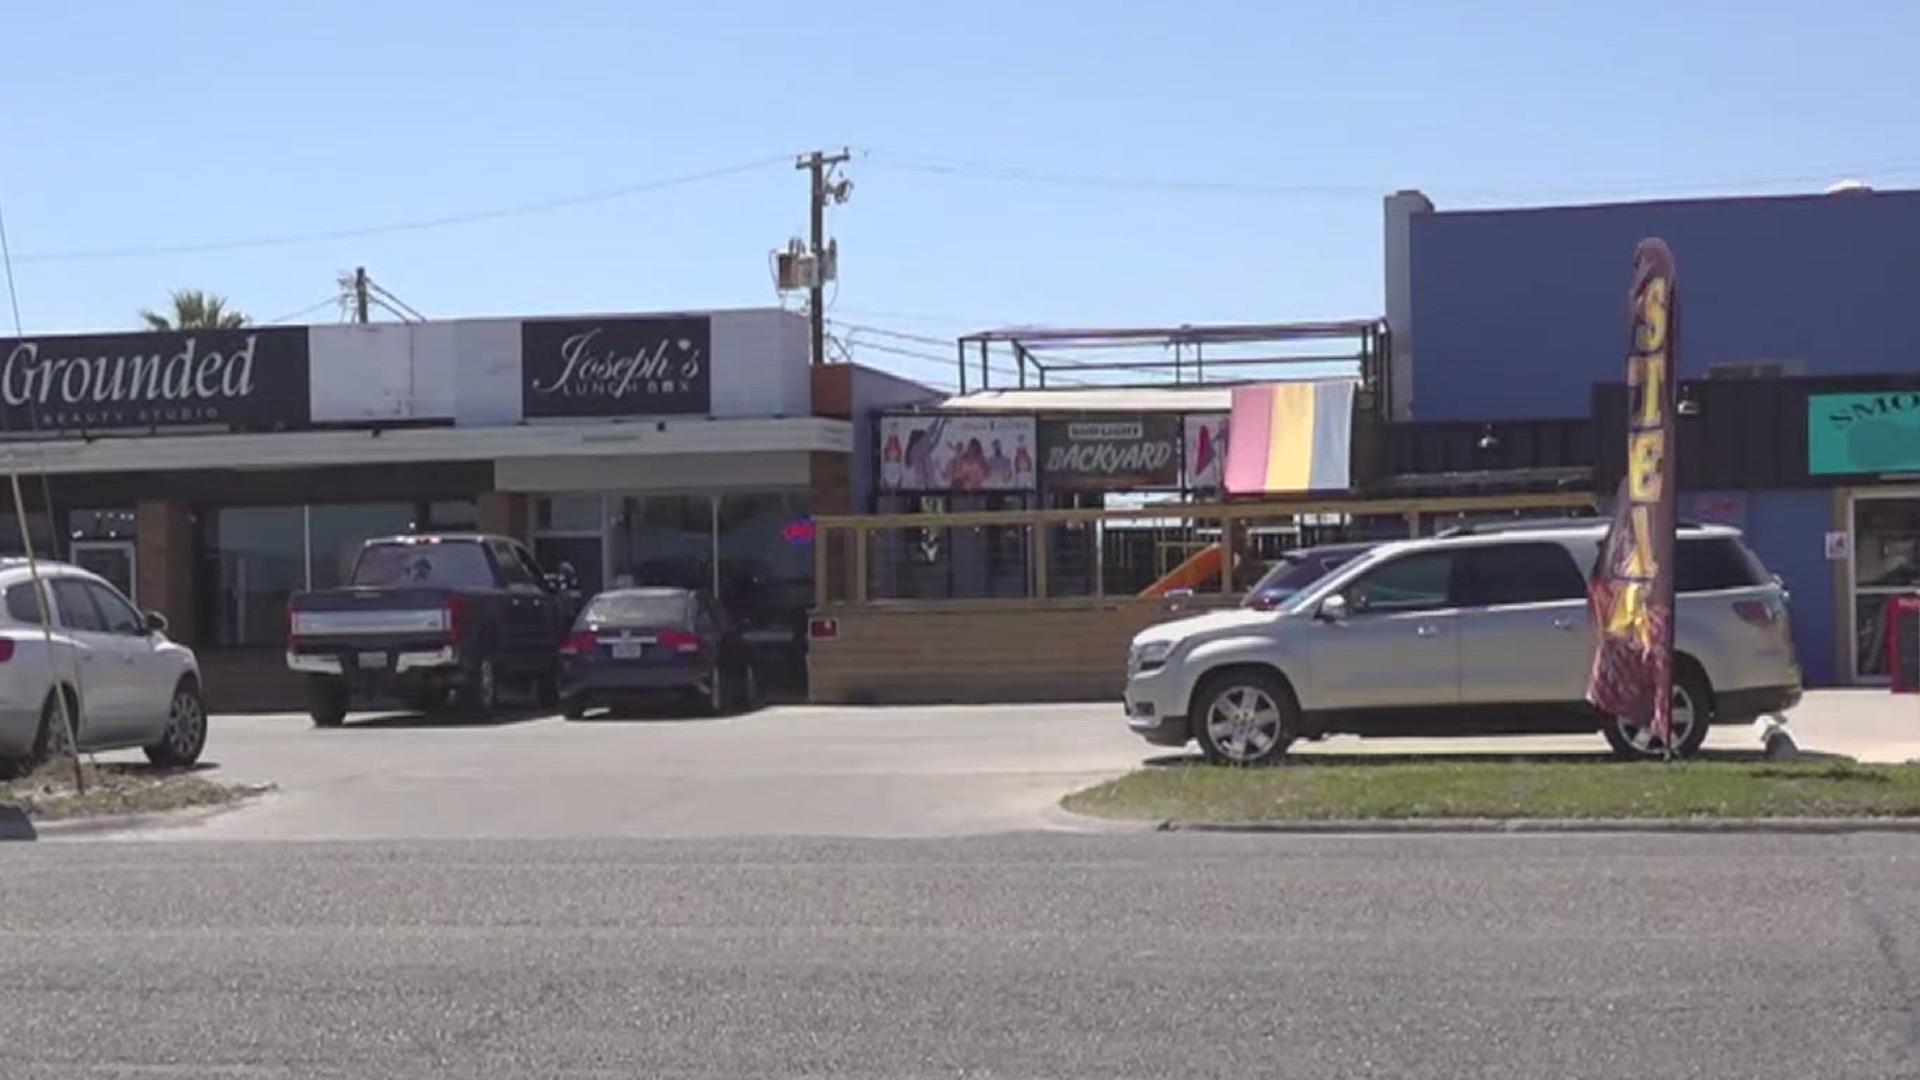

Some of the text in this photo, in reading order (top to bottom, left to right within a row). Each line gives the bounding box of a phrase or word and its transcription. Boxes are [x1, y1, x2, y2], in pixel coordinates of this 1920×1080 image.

[2, 336, 257, 405] Grounded
[533, 328, 699, 398] Joseph's
[43, 406, 219, 424] BEAUTY STUDIO
[1047, 440, 1172, 473] BACKYARD
